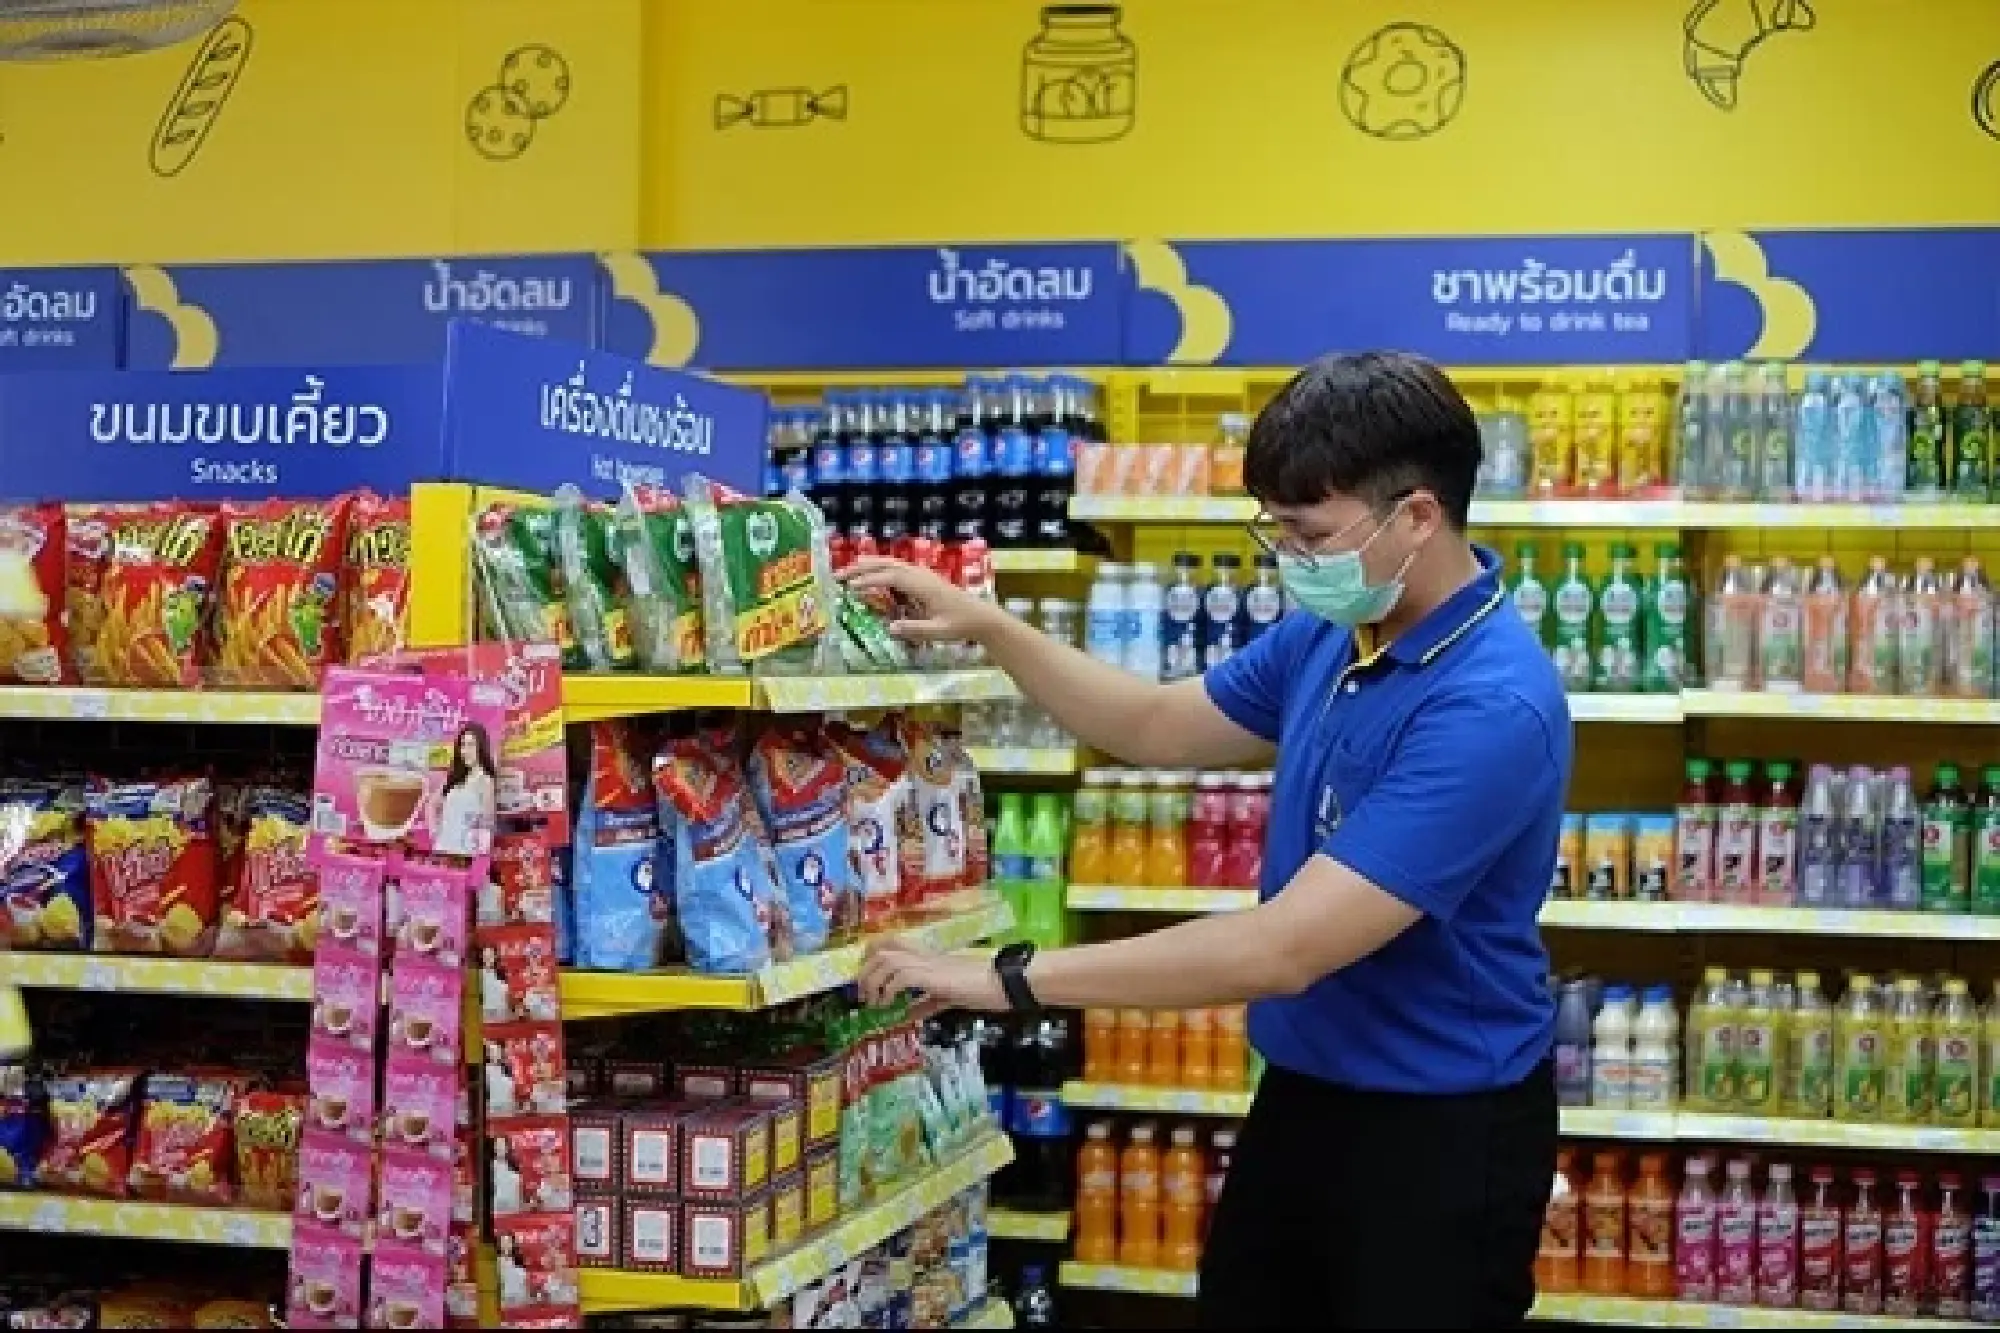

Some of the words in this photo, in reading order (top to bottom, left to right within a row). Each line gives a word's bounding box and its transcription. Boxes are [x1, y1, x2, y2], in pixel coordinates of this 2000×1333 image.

[424, 259, 571, 311] น้ำอัดลม
[929, 248, 1093, 303] น้ำอัดลม
[1432, 248, 1666, 303] ชาพร้อมดื่ม
[1001, 306, 1065, 330] drinks
[1445, 312, 1513, 335] Ready
[1520, 312, 1543, 332] to
[1549, 310, 1607, 332] drink
[1613, 312, 1648, 332] tea
[90, 374, 389, 446] ขนมขบเคี้ยว
[190, 457, 278, 484] Snacks
